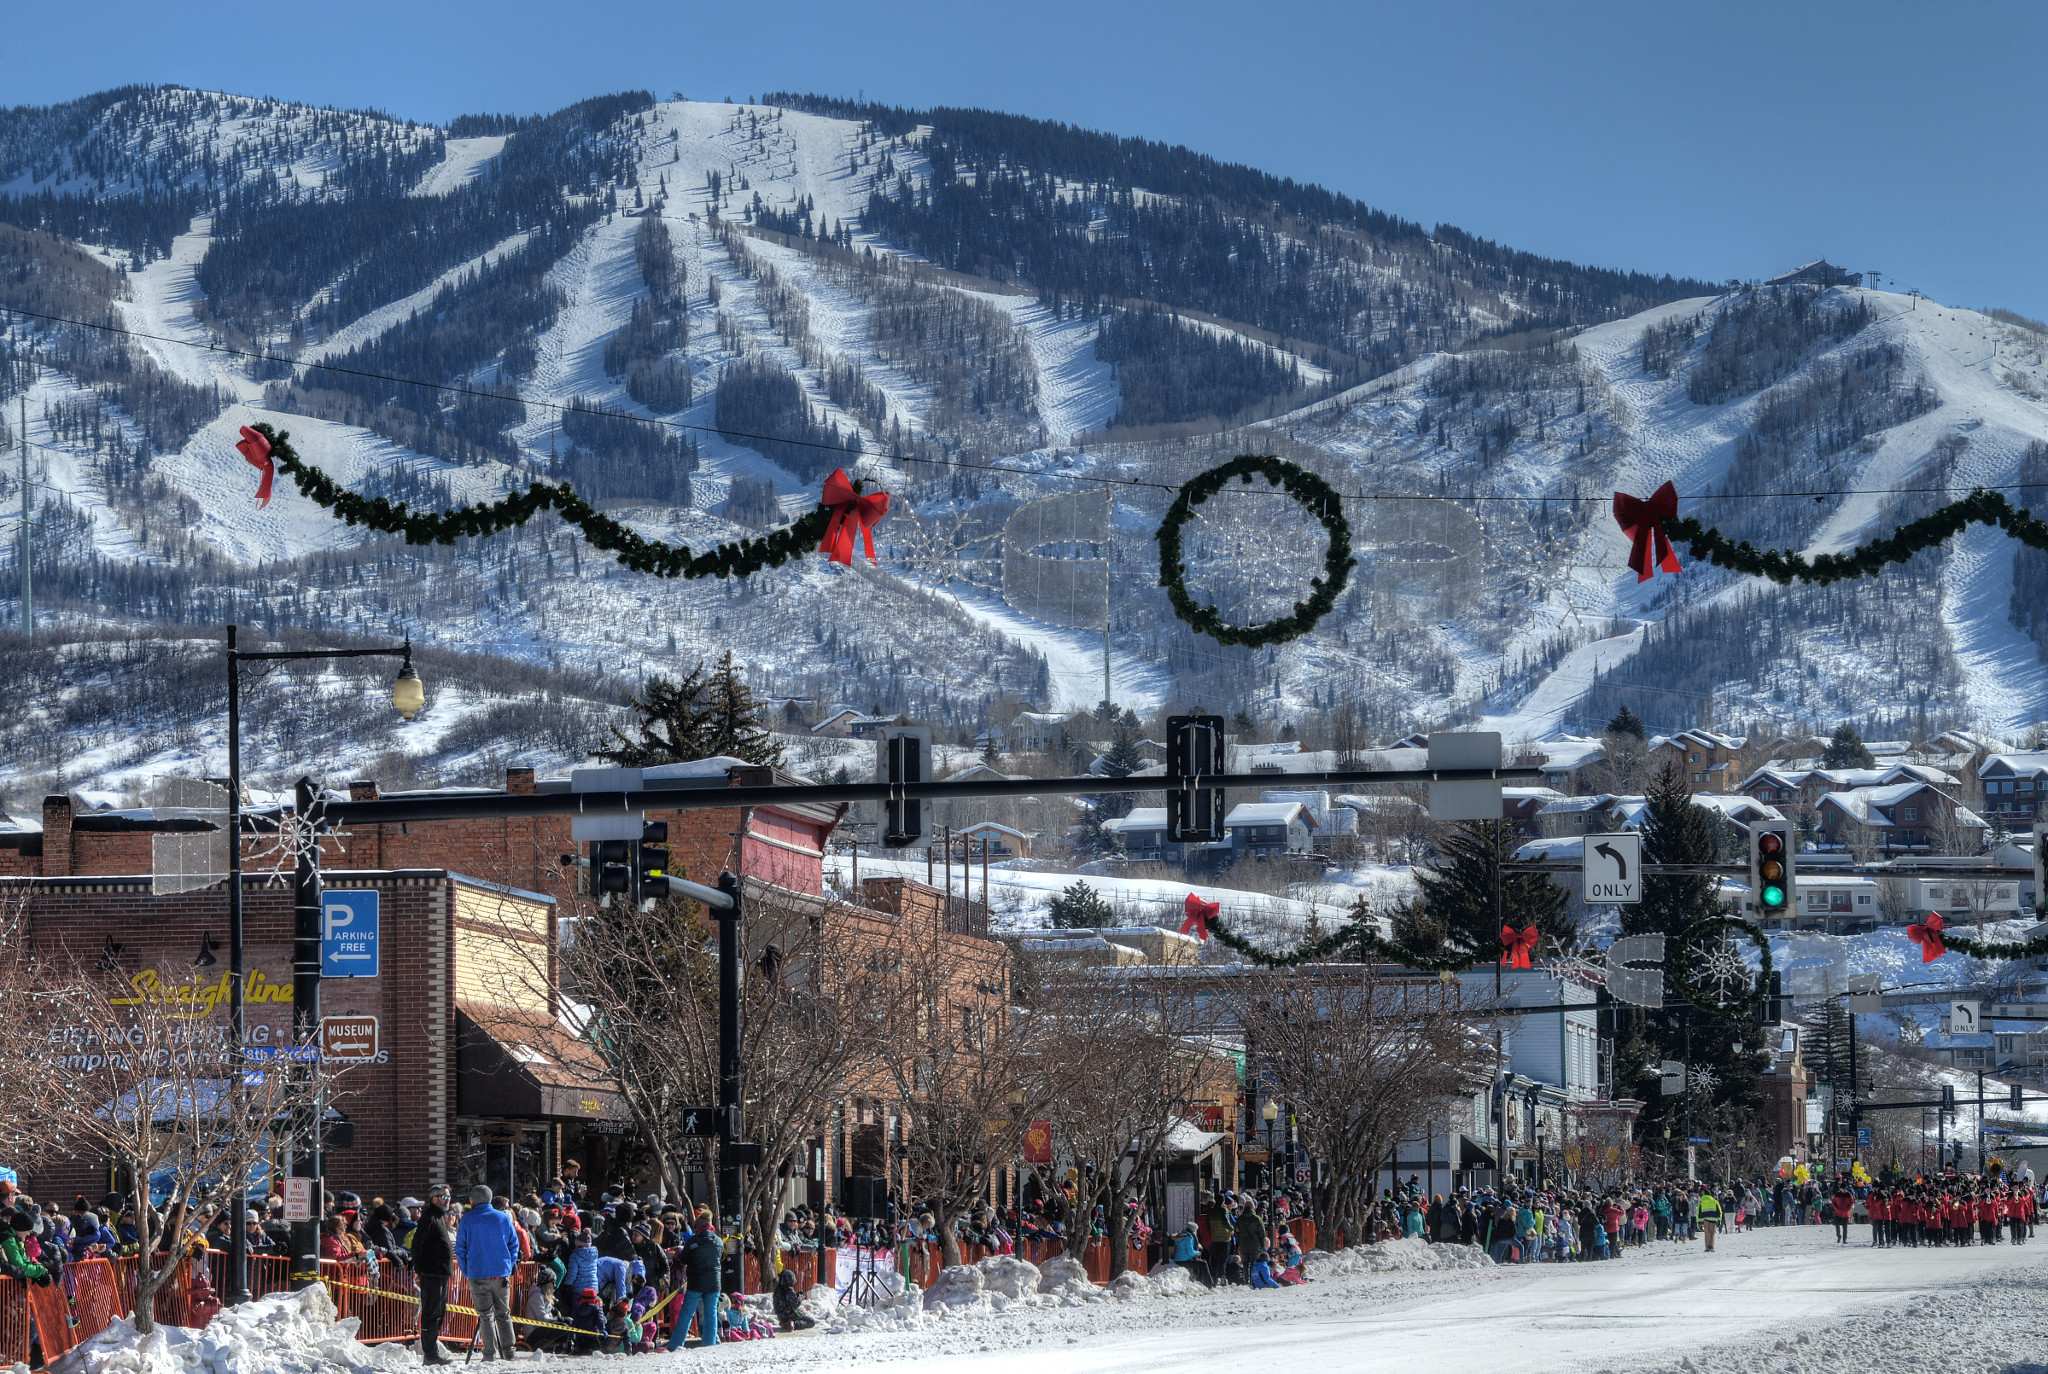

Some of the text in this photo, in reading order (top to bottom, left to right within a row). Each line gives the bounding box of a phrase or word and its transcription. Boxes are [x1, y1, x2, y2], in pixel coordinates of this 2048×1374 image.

[1592, 883, 1633, 897] ONLY
[340, 942, 366, 952] FREE
[110, 968, 295, 1019] Sraighline
[327, 1024, 373, 1037] MUSEUM
[1954, 1024, 1975, 1032] ONLY
[174, 1025, 270, 1045] HUNTG
[246, 1048, 268, 1061] 8th
[52, 1052, 134, 1072] amping
[292, 1182, 302, 1190] NO
